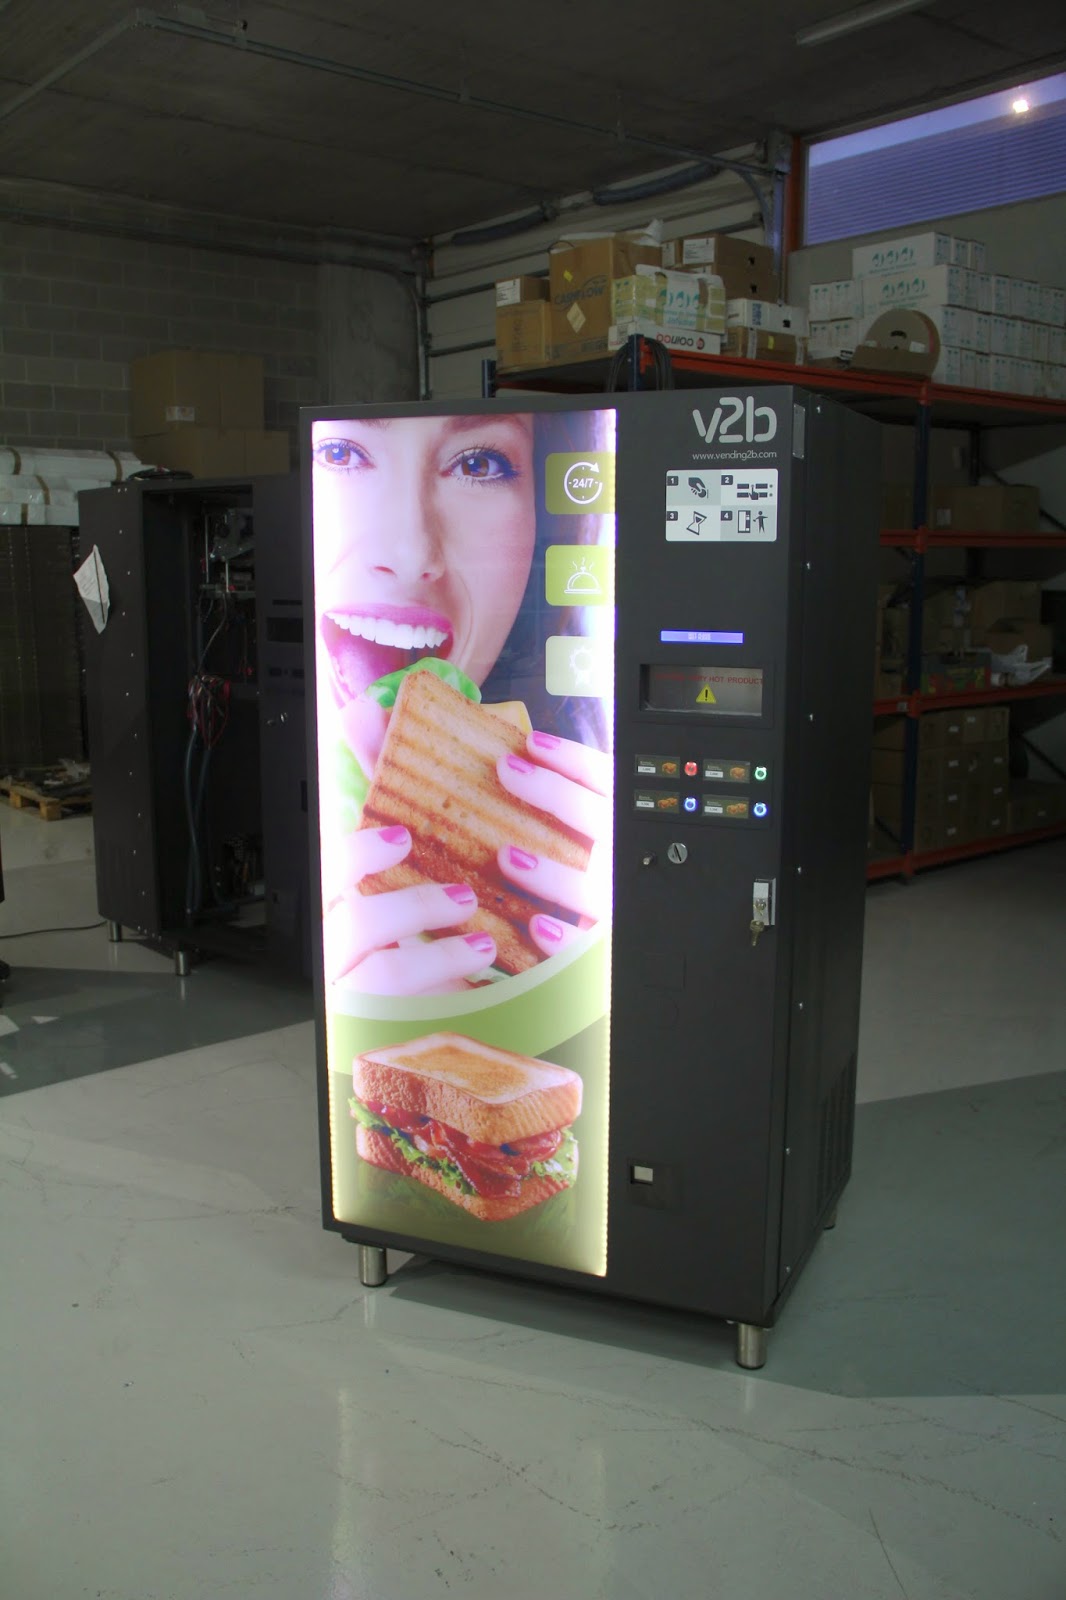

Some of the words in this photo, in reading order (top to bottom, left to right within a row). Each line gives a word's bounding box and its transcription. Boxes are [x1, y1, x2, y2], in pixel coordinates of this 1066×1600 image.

[656, 332, 694, 347] coinco
[692, 395, 778, 443] v2b
[692, 449, 777, 461] www.vending2b.com
[572, 477, 594, 489] 24/7
[708, 675, 725, 683] HOT
